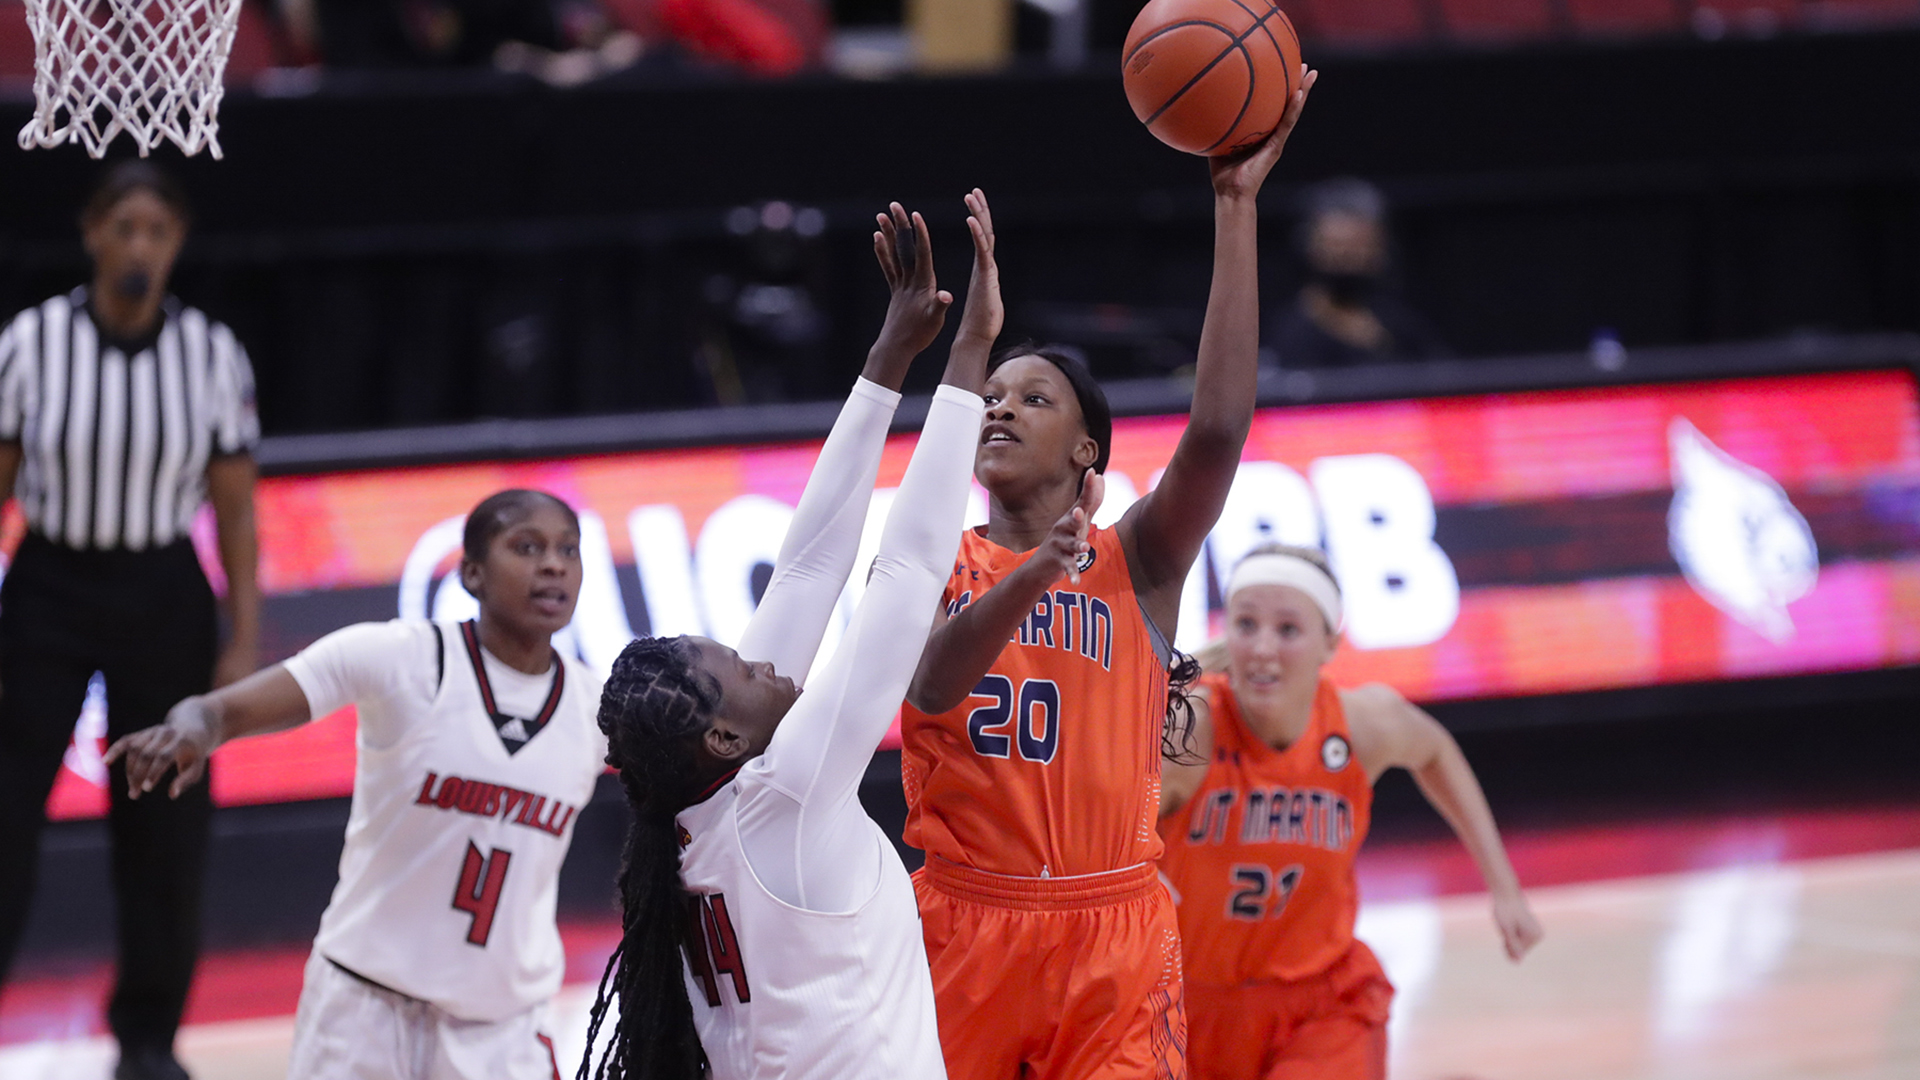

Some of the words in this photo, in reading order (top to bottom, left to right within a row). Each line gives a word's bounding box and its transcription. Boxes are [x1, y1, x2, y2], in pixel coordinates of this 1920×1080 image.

[967, 673, 1060, 765] 20
[452, 837, 512, 947] 4
[1228, 865, 1303, 919] 21
